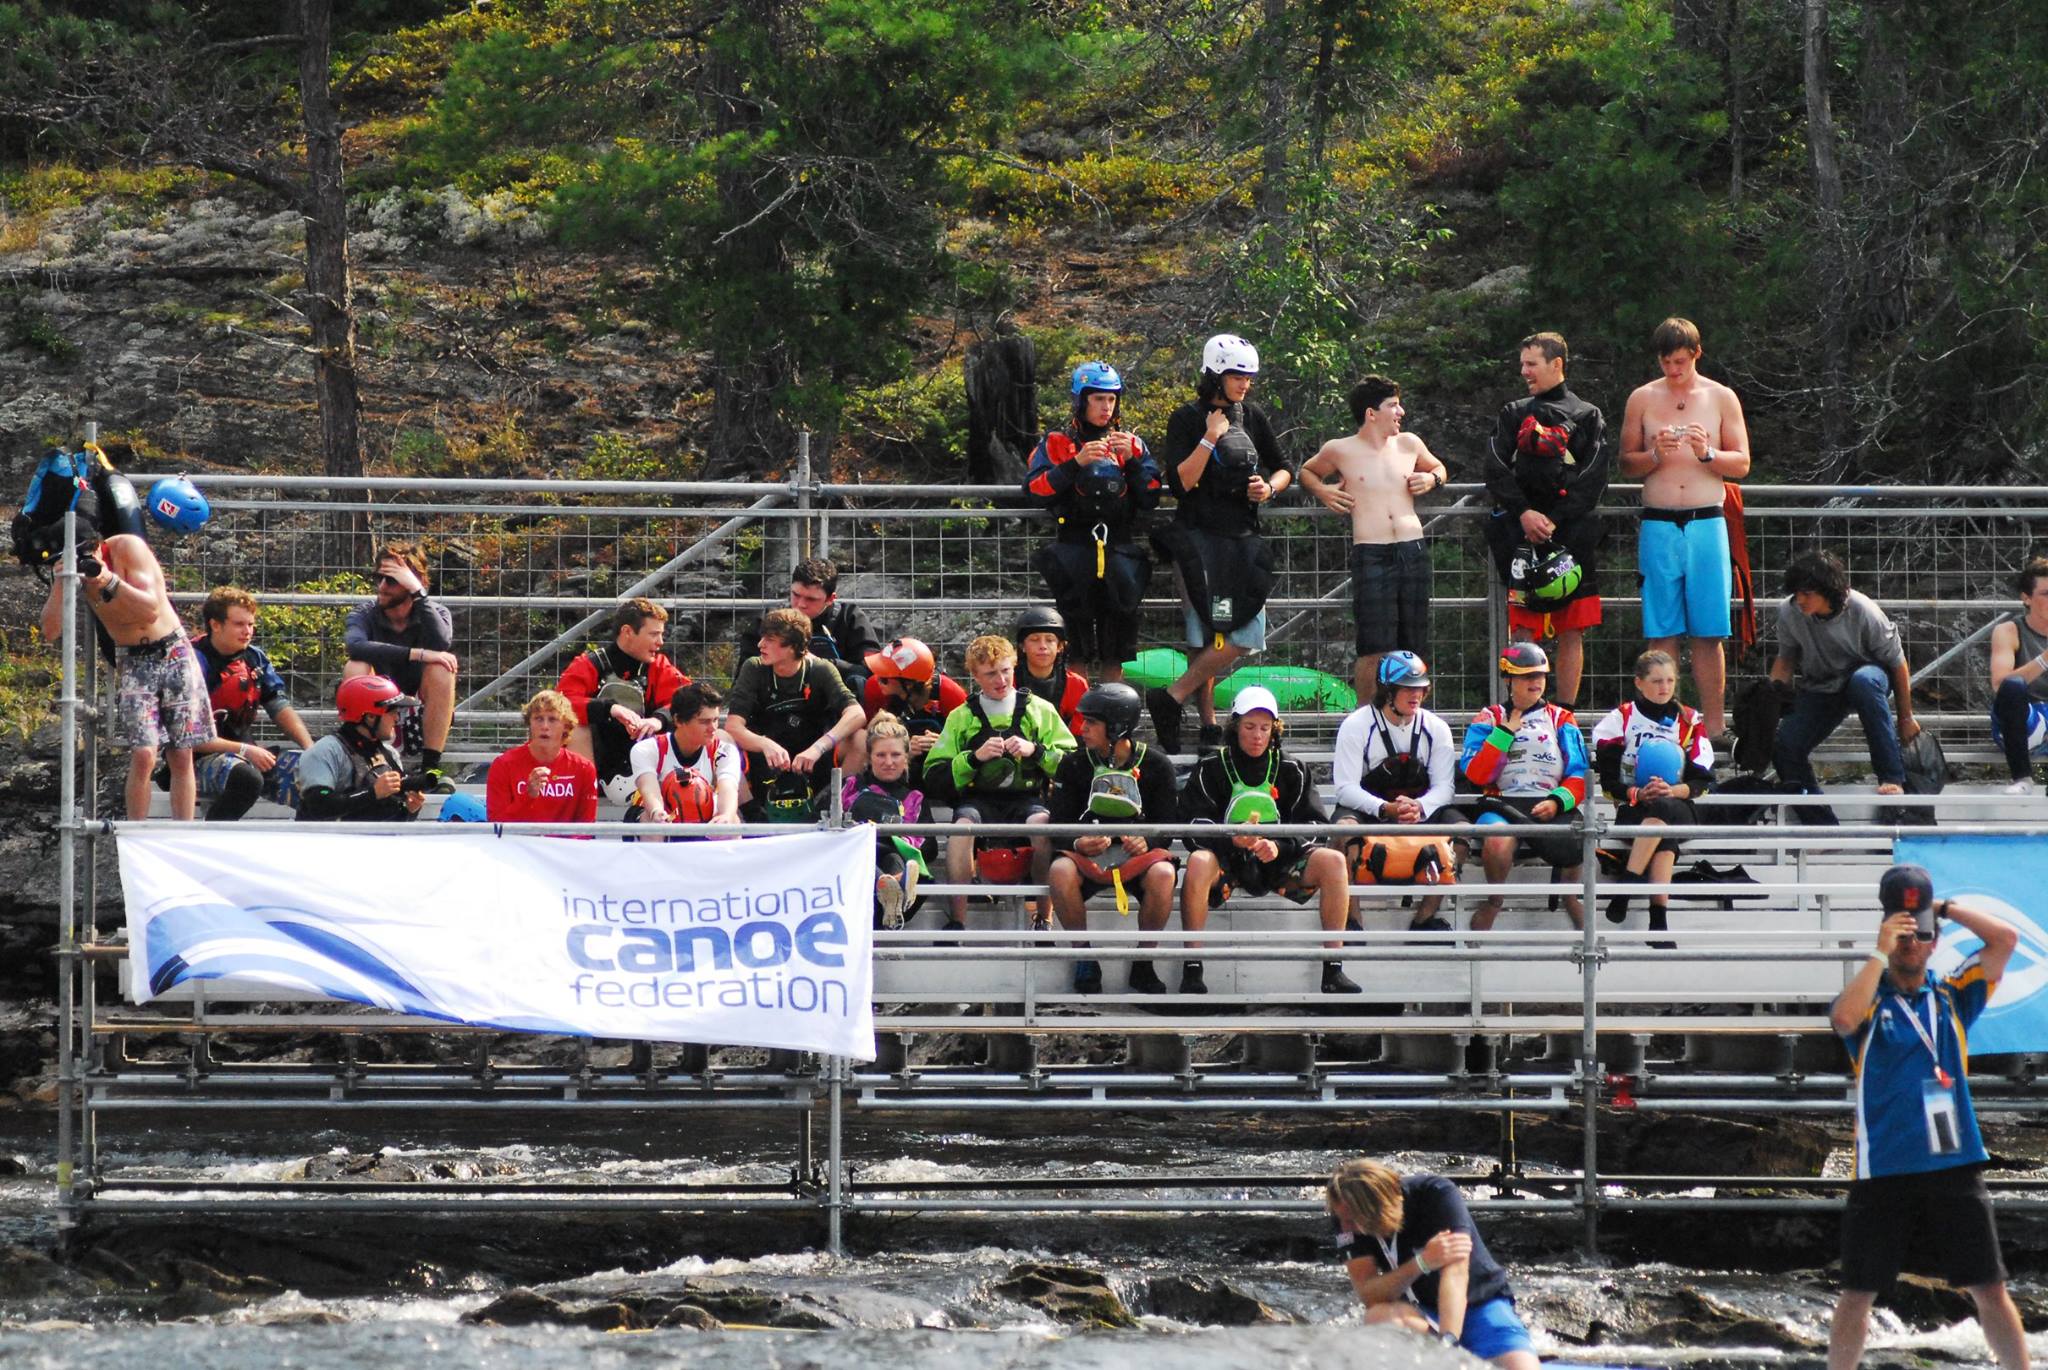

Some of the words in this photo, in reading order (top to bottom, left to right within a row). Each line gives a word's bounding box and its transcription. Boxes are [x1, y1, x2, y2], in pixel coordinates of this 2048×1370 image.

[517, 780, 574, 797] CNADA
[562, 874, 845, 924] international
[566, 911, 848, 973] canoe
[569, 971, 848, 1016] federation
